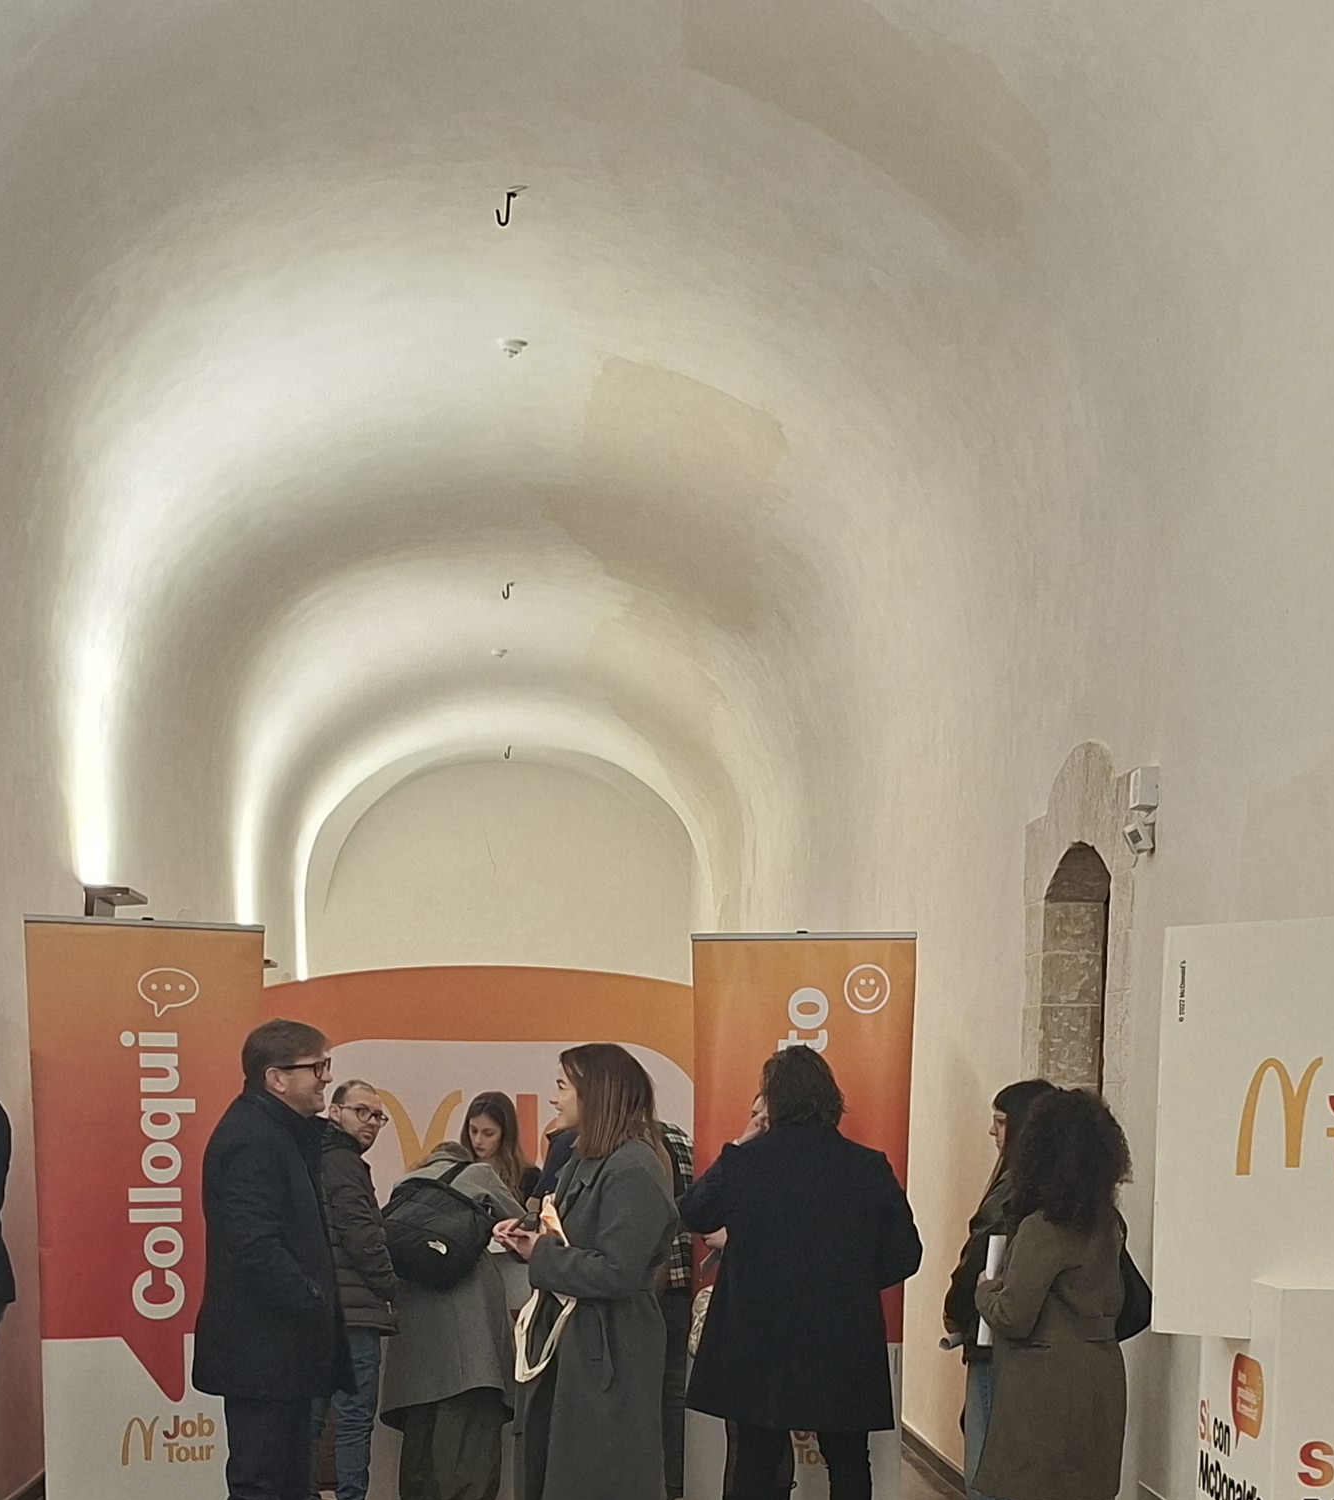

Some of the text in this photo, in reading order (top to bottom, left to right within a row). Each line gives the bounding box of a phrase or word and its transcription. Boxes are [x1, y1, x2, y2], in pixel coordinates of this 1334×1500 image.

[120, 1030, 197, 1320] Colloqui
[162, 1413, 215, 1440] Job
[1212, 1417, 1231, 1458] con
[163, 1441, 215, 1463] Tour
